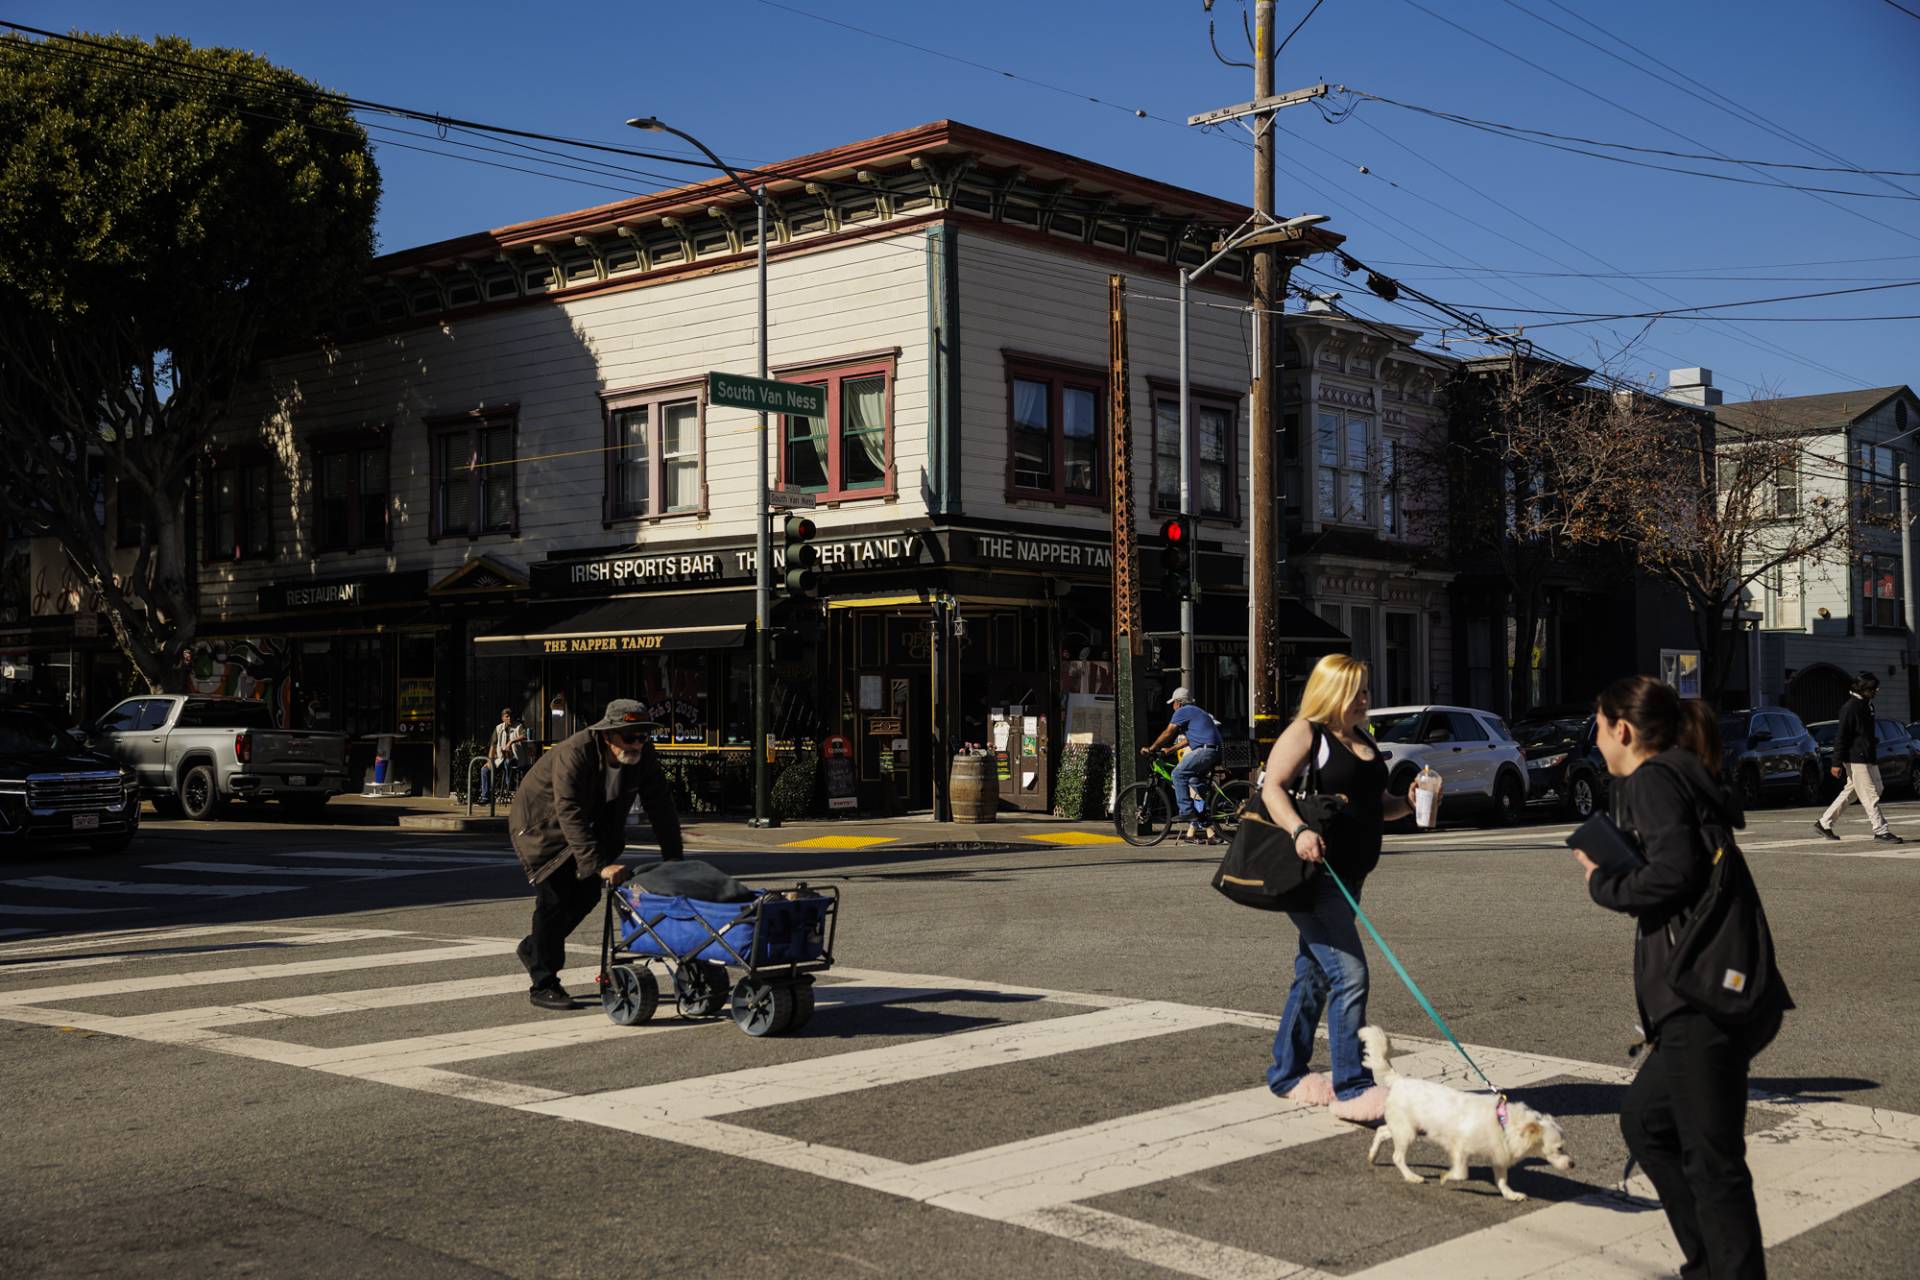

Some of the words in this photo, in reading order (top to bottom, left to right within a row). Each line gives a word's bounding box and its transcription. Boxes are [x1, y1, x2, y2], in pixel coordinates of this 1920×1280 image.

[718, 381, 755, 402] South
[759, 387, 782, 405] Van
[787, 390, 817, 410] Ness
[736, 551, 758, 571] TH
[773, 543, 845, 569] NPER
[850, 536, 913, 562] TANDY
[980, 536, 1013, 559] THE
[1017, 540, 1081, 565] NAPPER
[1084, 547, 1113, 568] TAN
[571, 562, 610, 583] IRISH
[613, 557, 676, 579] SPORTS
[680, 554, 714, 575] BAR
[286, 583, 361, 607] RESTAURANT
[544, 640, 567, 652] THE
[571, 638, 617, 651] NAPPER
[621, 635, 664, 649] TANDY
